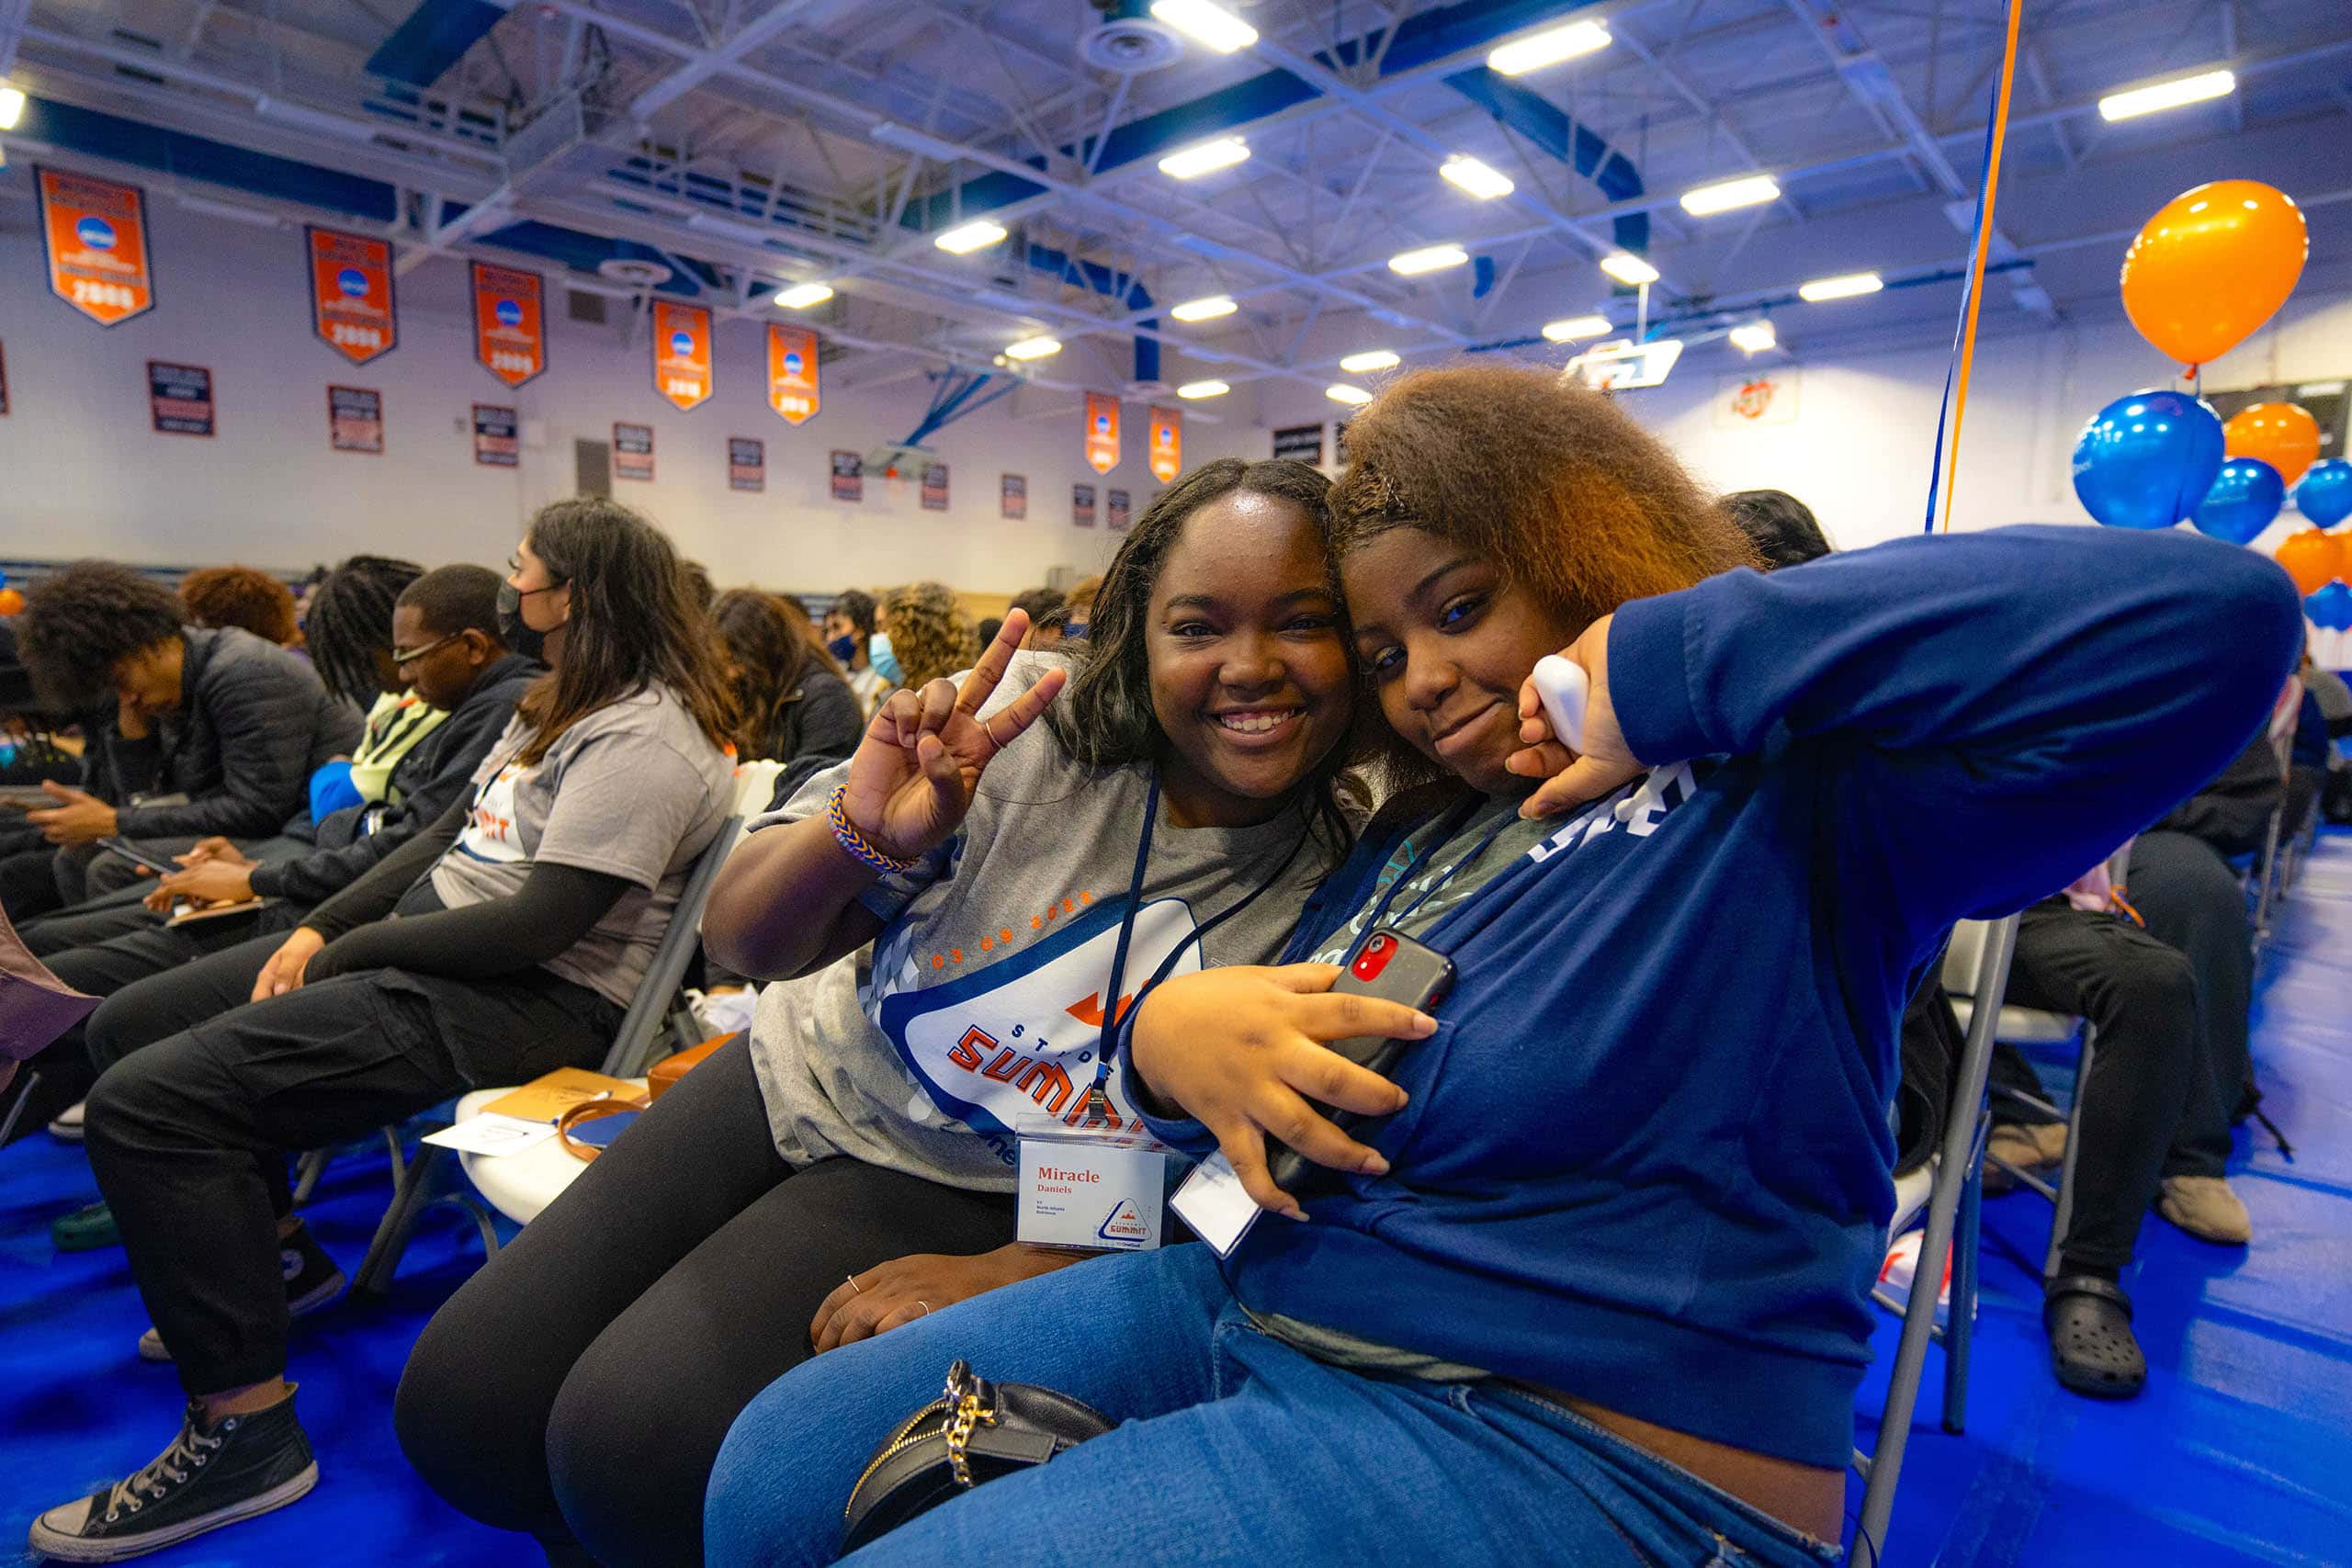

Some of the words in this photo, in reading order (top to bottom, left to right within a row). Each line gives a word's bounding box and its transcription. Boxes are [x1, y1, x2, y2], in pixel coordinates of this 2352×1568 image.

[932, 947, 963, 970] 03
[981, 927, 1013, 952] 09
[1030, 890, 1093, 930] 2022
[1038, 1167, 1101, 1183] Miracle
[1037, 1184, 1072, 1194] Daniels
[1110, 1224, 1148, 1235] SUMMIT
